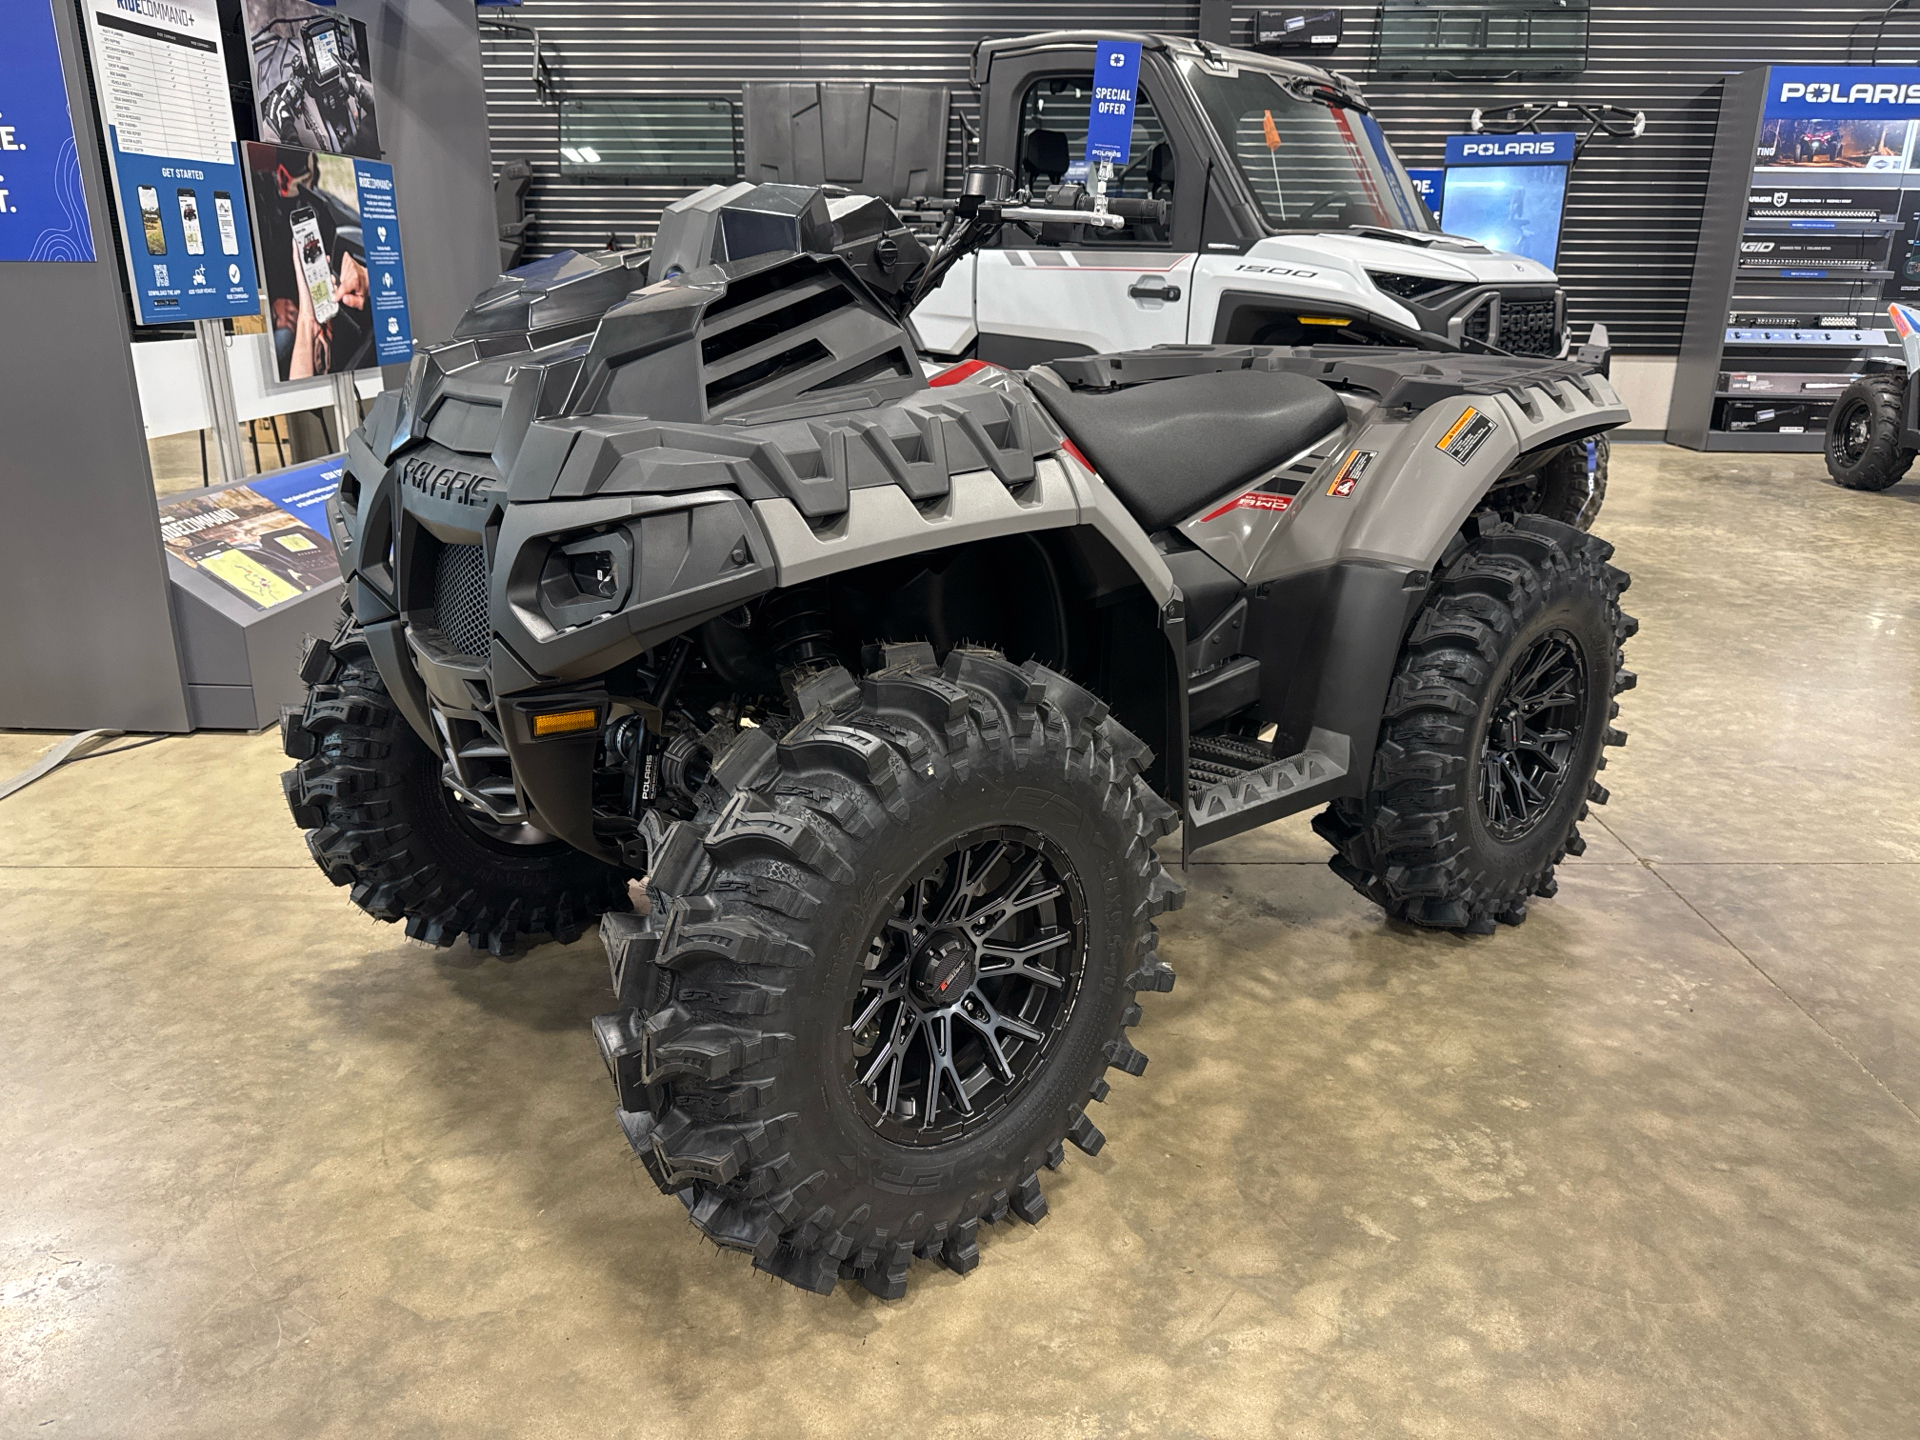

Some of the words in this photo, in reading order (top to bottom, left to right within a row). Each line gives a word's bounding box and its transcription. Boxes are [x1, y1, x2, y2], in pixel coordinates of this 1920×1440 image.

[1095, 87, 1131, 101] SPECIAL
[1780, 82, 1920, 105] POLARIS
[1098, 102, 1126, 115] OFFER
[1463, 142, 1555, 156] POLARIS
[162, 167, 174, 178] GET
[175, 168, 204, 180] STARTED
[1235, 265, 1318, 278] 1500
[642, 754, 653, 800] POLARIS
